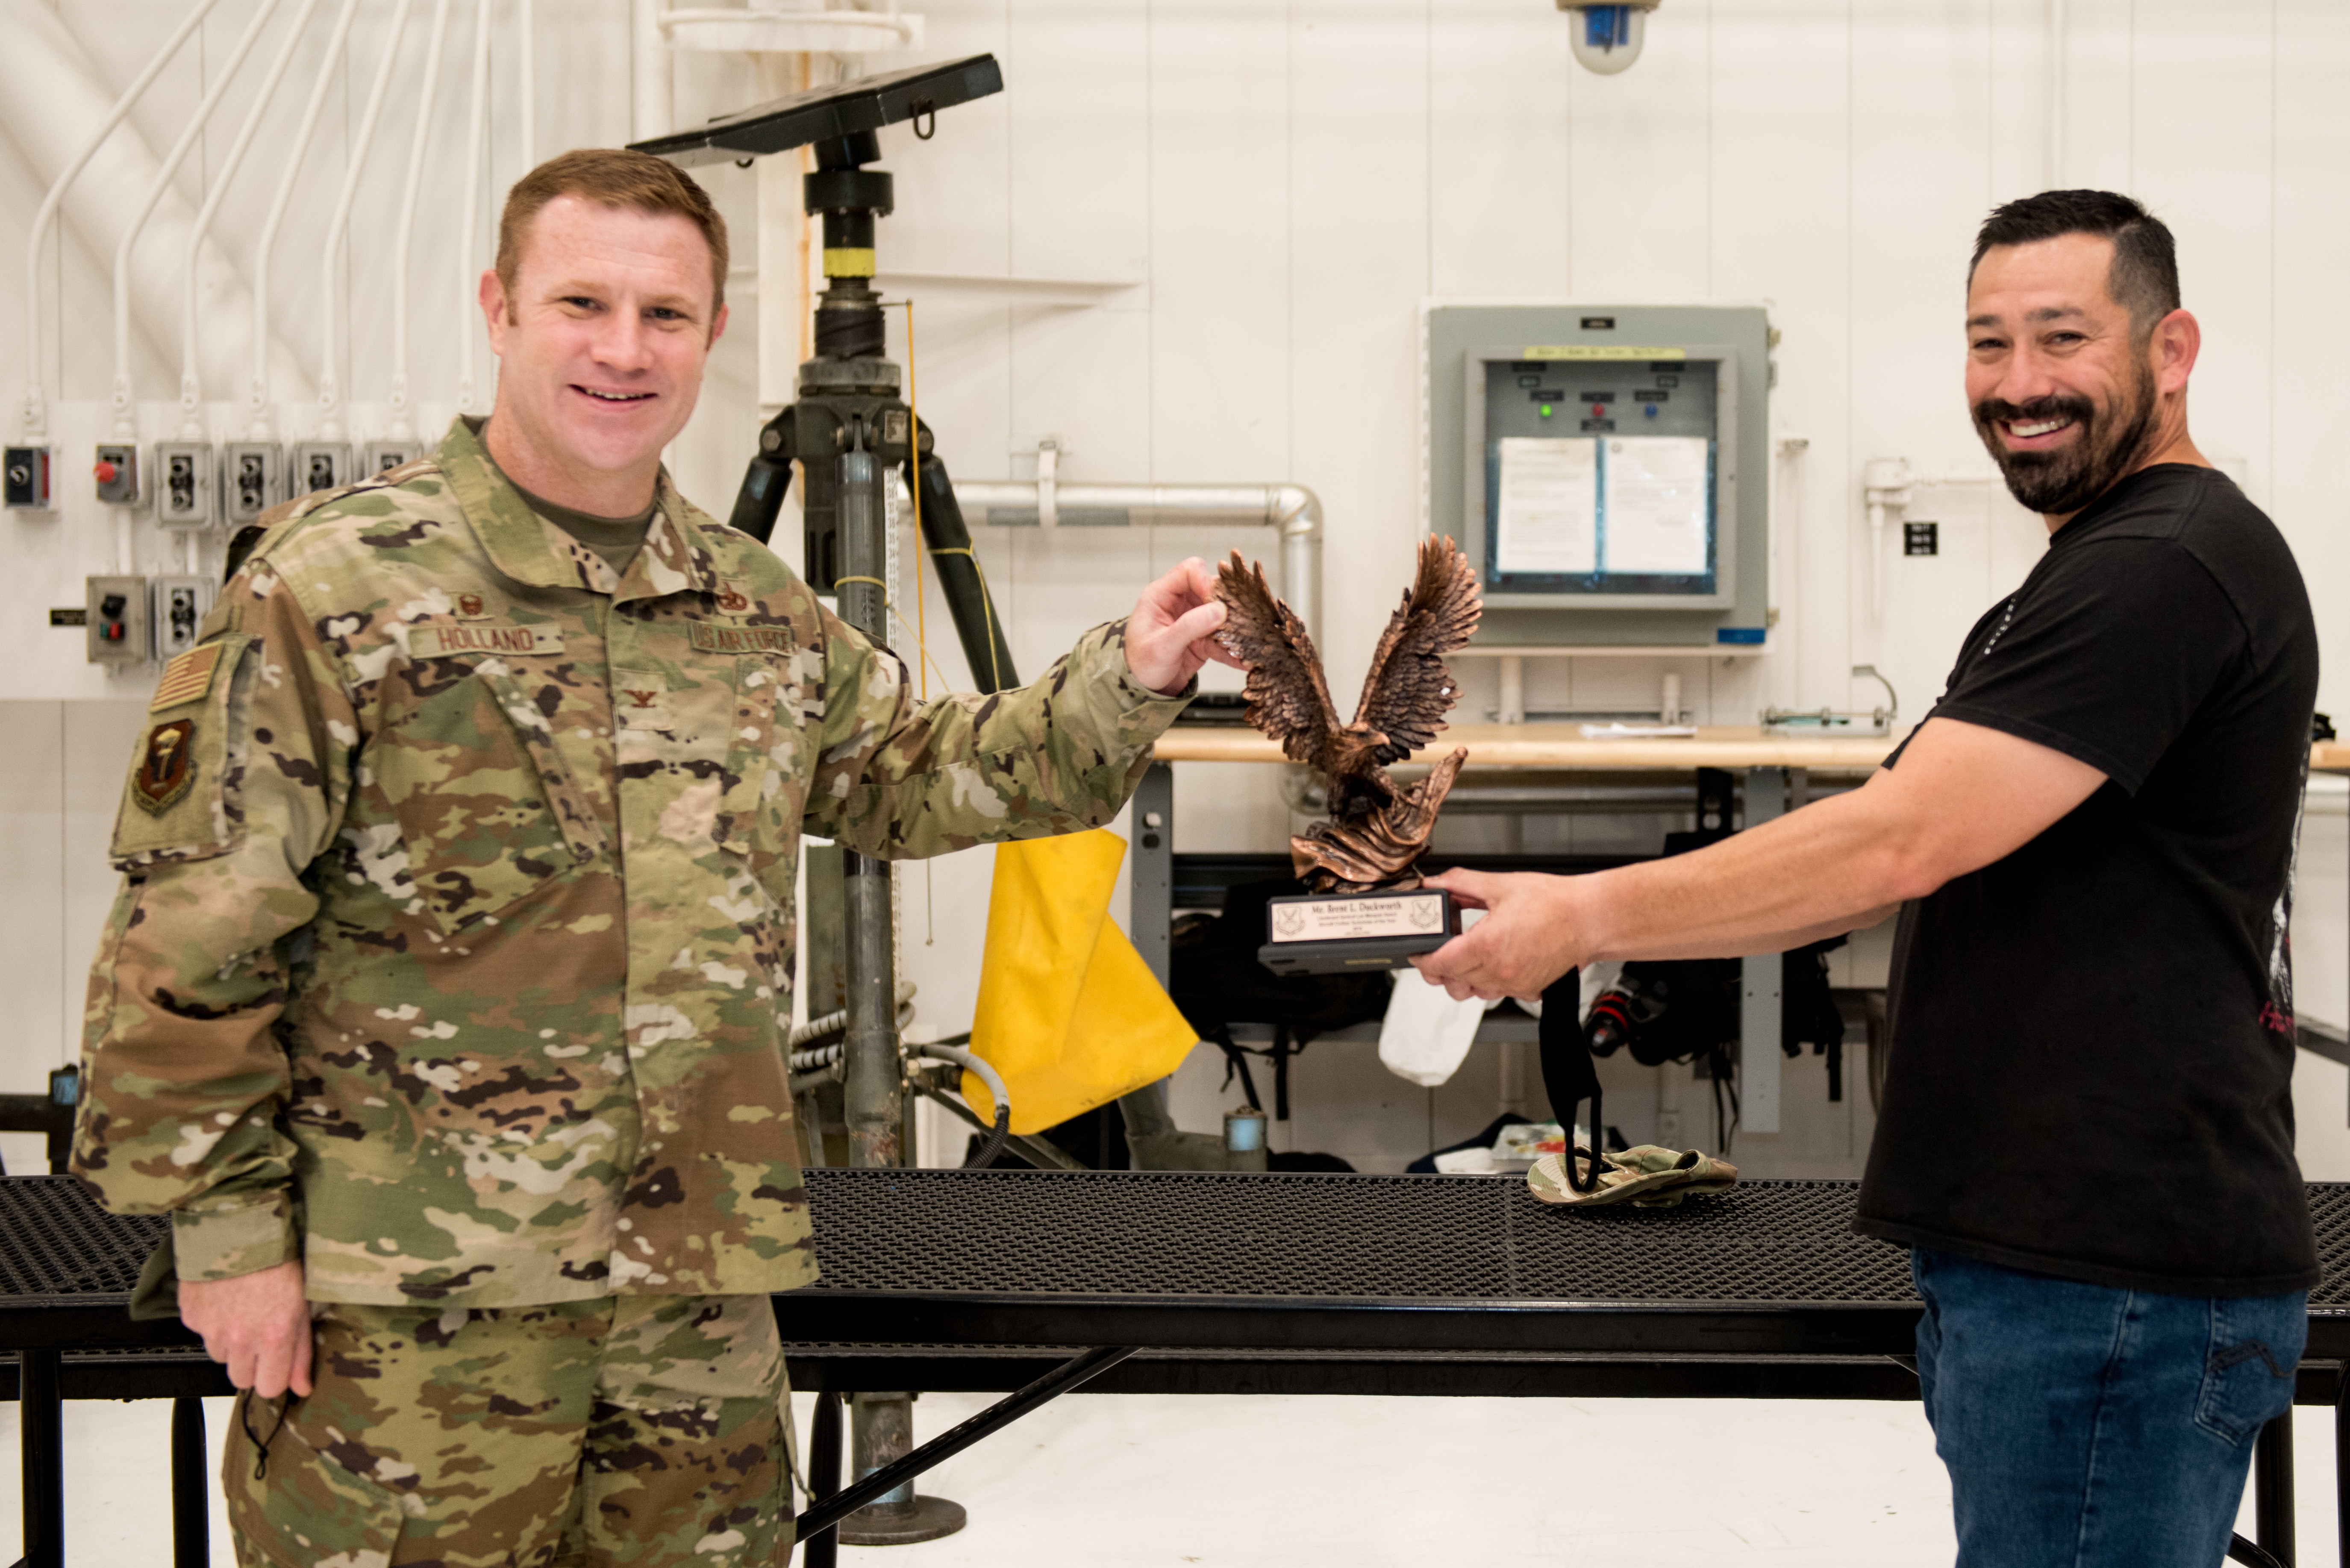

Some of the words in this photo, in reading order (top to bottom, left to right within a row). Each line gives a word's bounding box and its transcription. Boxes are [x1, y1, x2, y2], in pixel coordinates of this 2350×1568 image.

[888, 502, 894, 514] 37
[888, 532, 895, 545] 35
[888, 547, 895, 560] 34
[889, 562, 896, 575] 33
[889, 578, 896, 590] 32
[889, 623, 896, 635] 29
[436, 627, 534, 651] HOLLAND
[692, 623, 716, 648] US
[718, 629, 745, 651] AIR
[743, 628, 789, 653] FORCE
[1359, 901, 1402, 912] Duckworth
